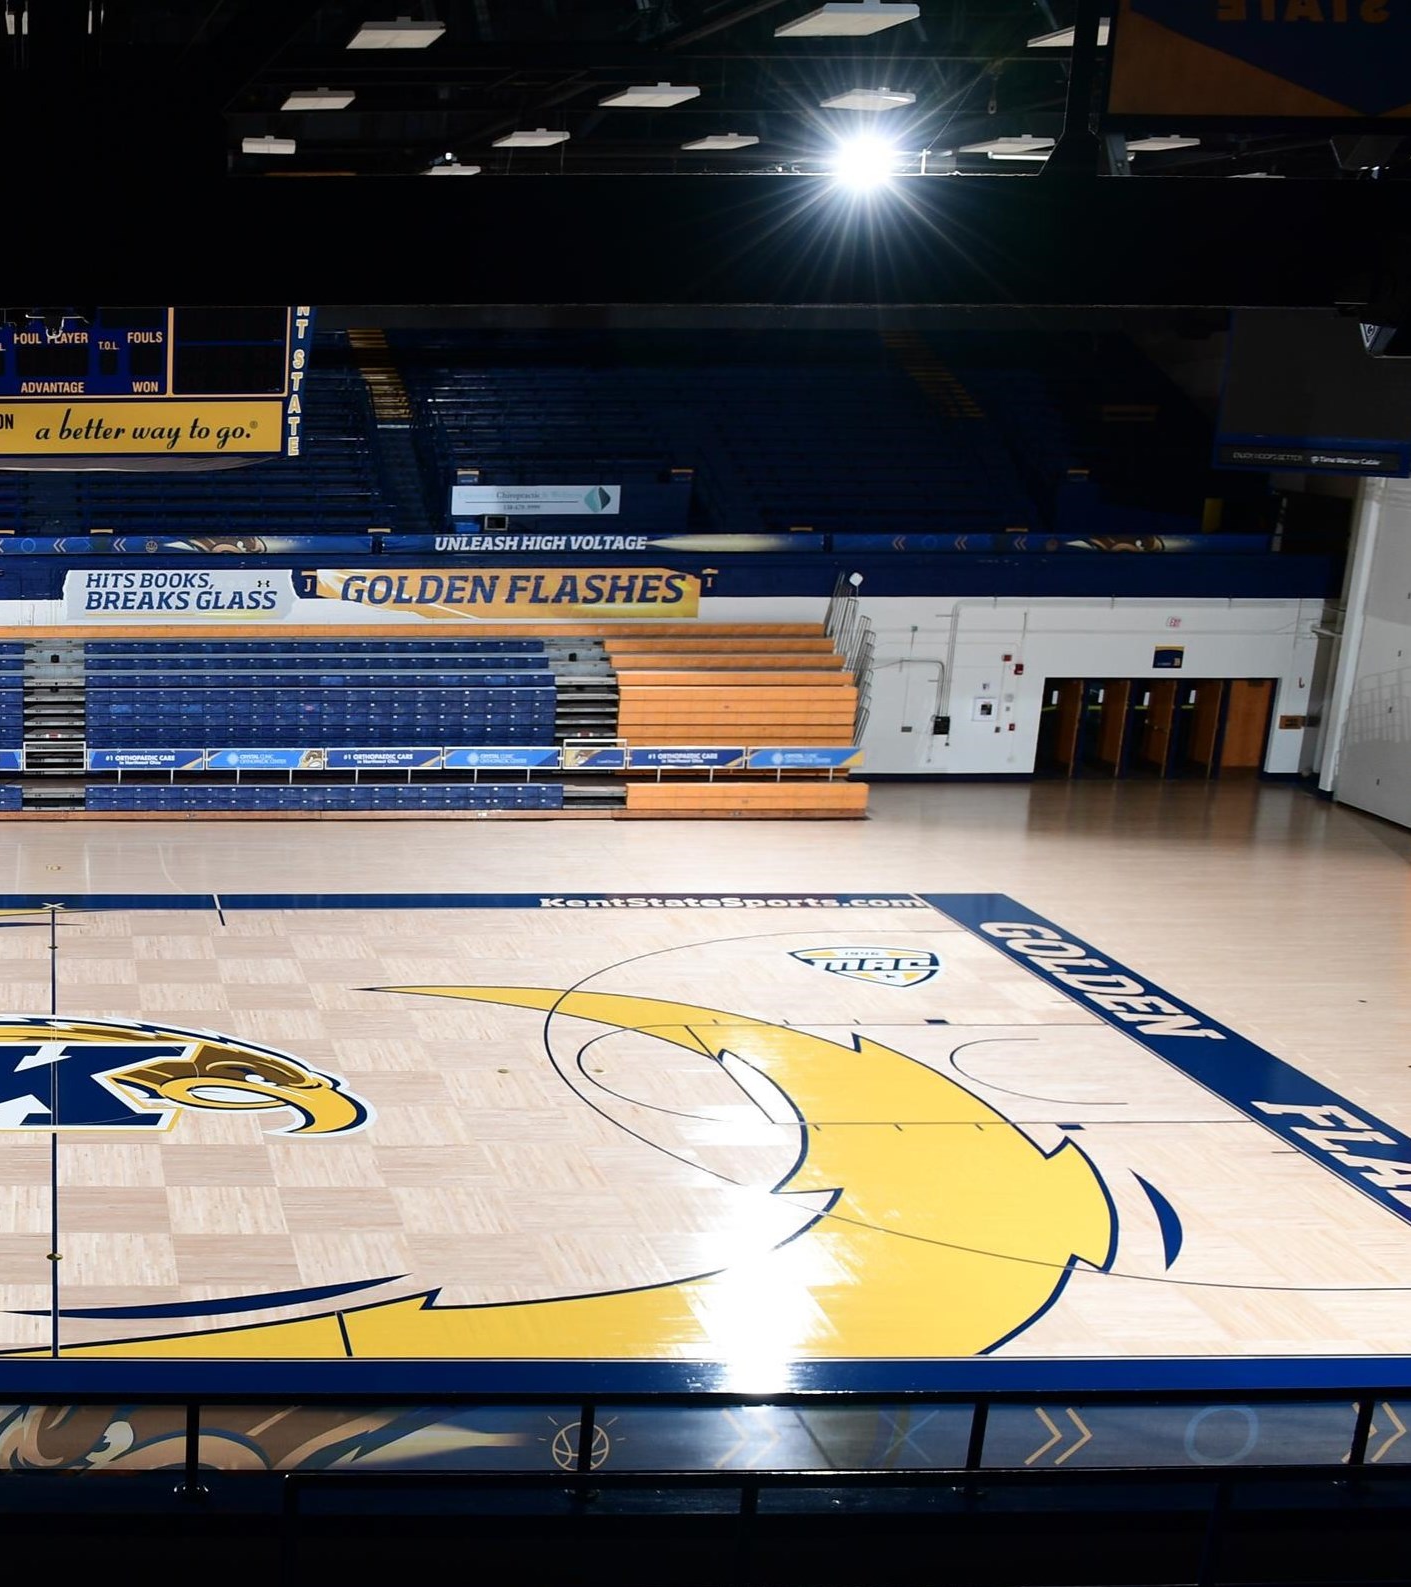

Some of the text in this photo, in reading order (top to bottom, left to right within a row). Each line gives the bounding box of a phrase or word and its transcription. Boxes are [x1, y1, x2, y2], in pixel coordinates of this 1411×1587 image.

[127, 332, 163, 344] FOULS
[21, 381, 85, 393] ADVANTAGE
[132, 381, 158, 393] WON
[287, 349, 305, 456] STATE
[35, 427, 50, 440] a
[59, 408, 126, 440] better
[132, 427, 181, 450] way
[189, 418, 210, 439] to
[435, 536, 648, 551] UNLEASH HIGH VOLTAGE
[85, 572, 214, 590] HITS BOOKS,
[341, 573, 686, 605] GOLDEN FLASHES
[85, 590, 278, 610] BREAKS GLASS
[539, 897, 922, 910] KentStateSports.com
[979, 921, 1411, 1208] GOLDEN FLA
